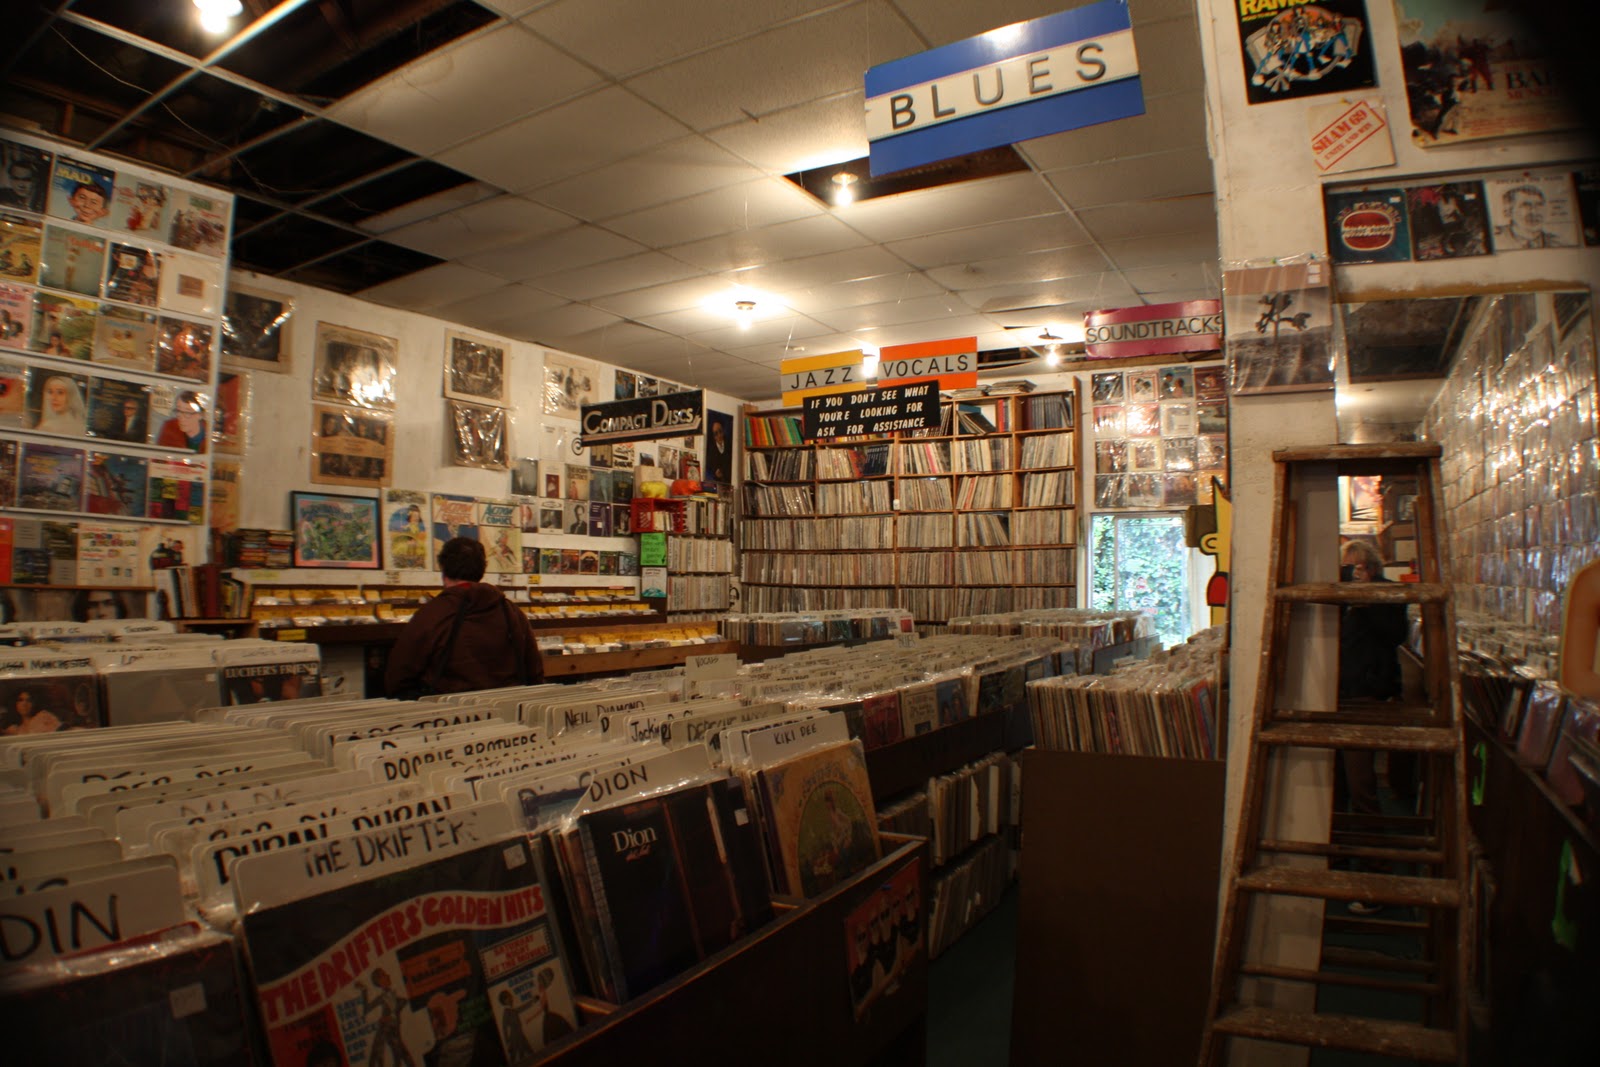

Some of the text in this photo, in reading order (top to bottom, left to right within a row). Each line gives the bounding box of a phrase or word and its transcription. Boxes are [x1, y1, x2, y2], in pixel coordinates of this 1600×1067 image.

[890, 42, 1106, 130] BLUES
[1312, 109, 1367, 155] SHAM 69
[56, 166, 92, 185] MAD
[1086, 315, 1222, 344] SOUNDTRACKS
[791, 366, 853, 390] JAZZ
[882, 354, 969, 378] VOCALS
[810, 398, 821, 409] IF
[825, 396, 843, 407] YOU
[881, 389, 898, 401] SEE
[904, 385, 930, 398] WHAT
[860, 405, 898, 419] LOOKING
[906, 402, 923, 413] FOR
[817, 417, 925, 437] ASK FOR ASSISTANCE
[31, 657, 91, 670] MANCHESTER
[695, 656, 719, 668] VOCALS
[565, 708, 592, 730] NEIL
[773, 729, 796, 755] KIKI
[800, 723, 817, 747] DEE
[588, 764, 648, 802] DION
[611, 826, 658, 854] Dion
[304, 839, 349, 879] THE
[260, 969, 322, 1024] THE
[421, 896, 503, 927] GOLDEN
[504, 886, 545, 922] HITS
